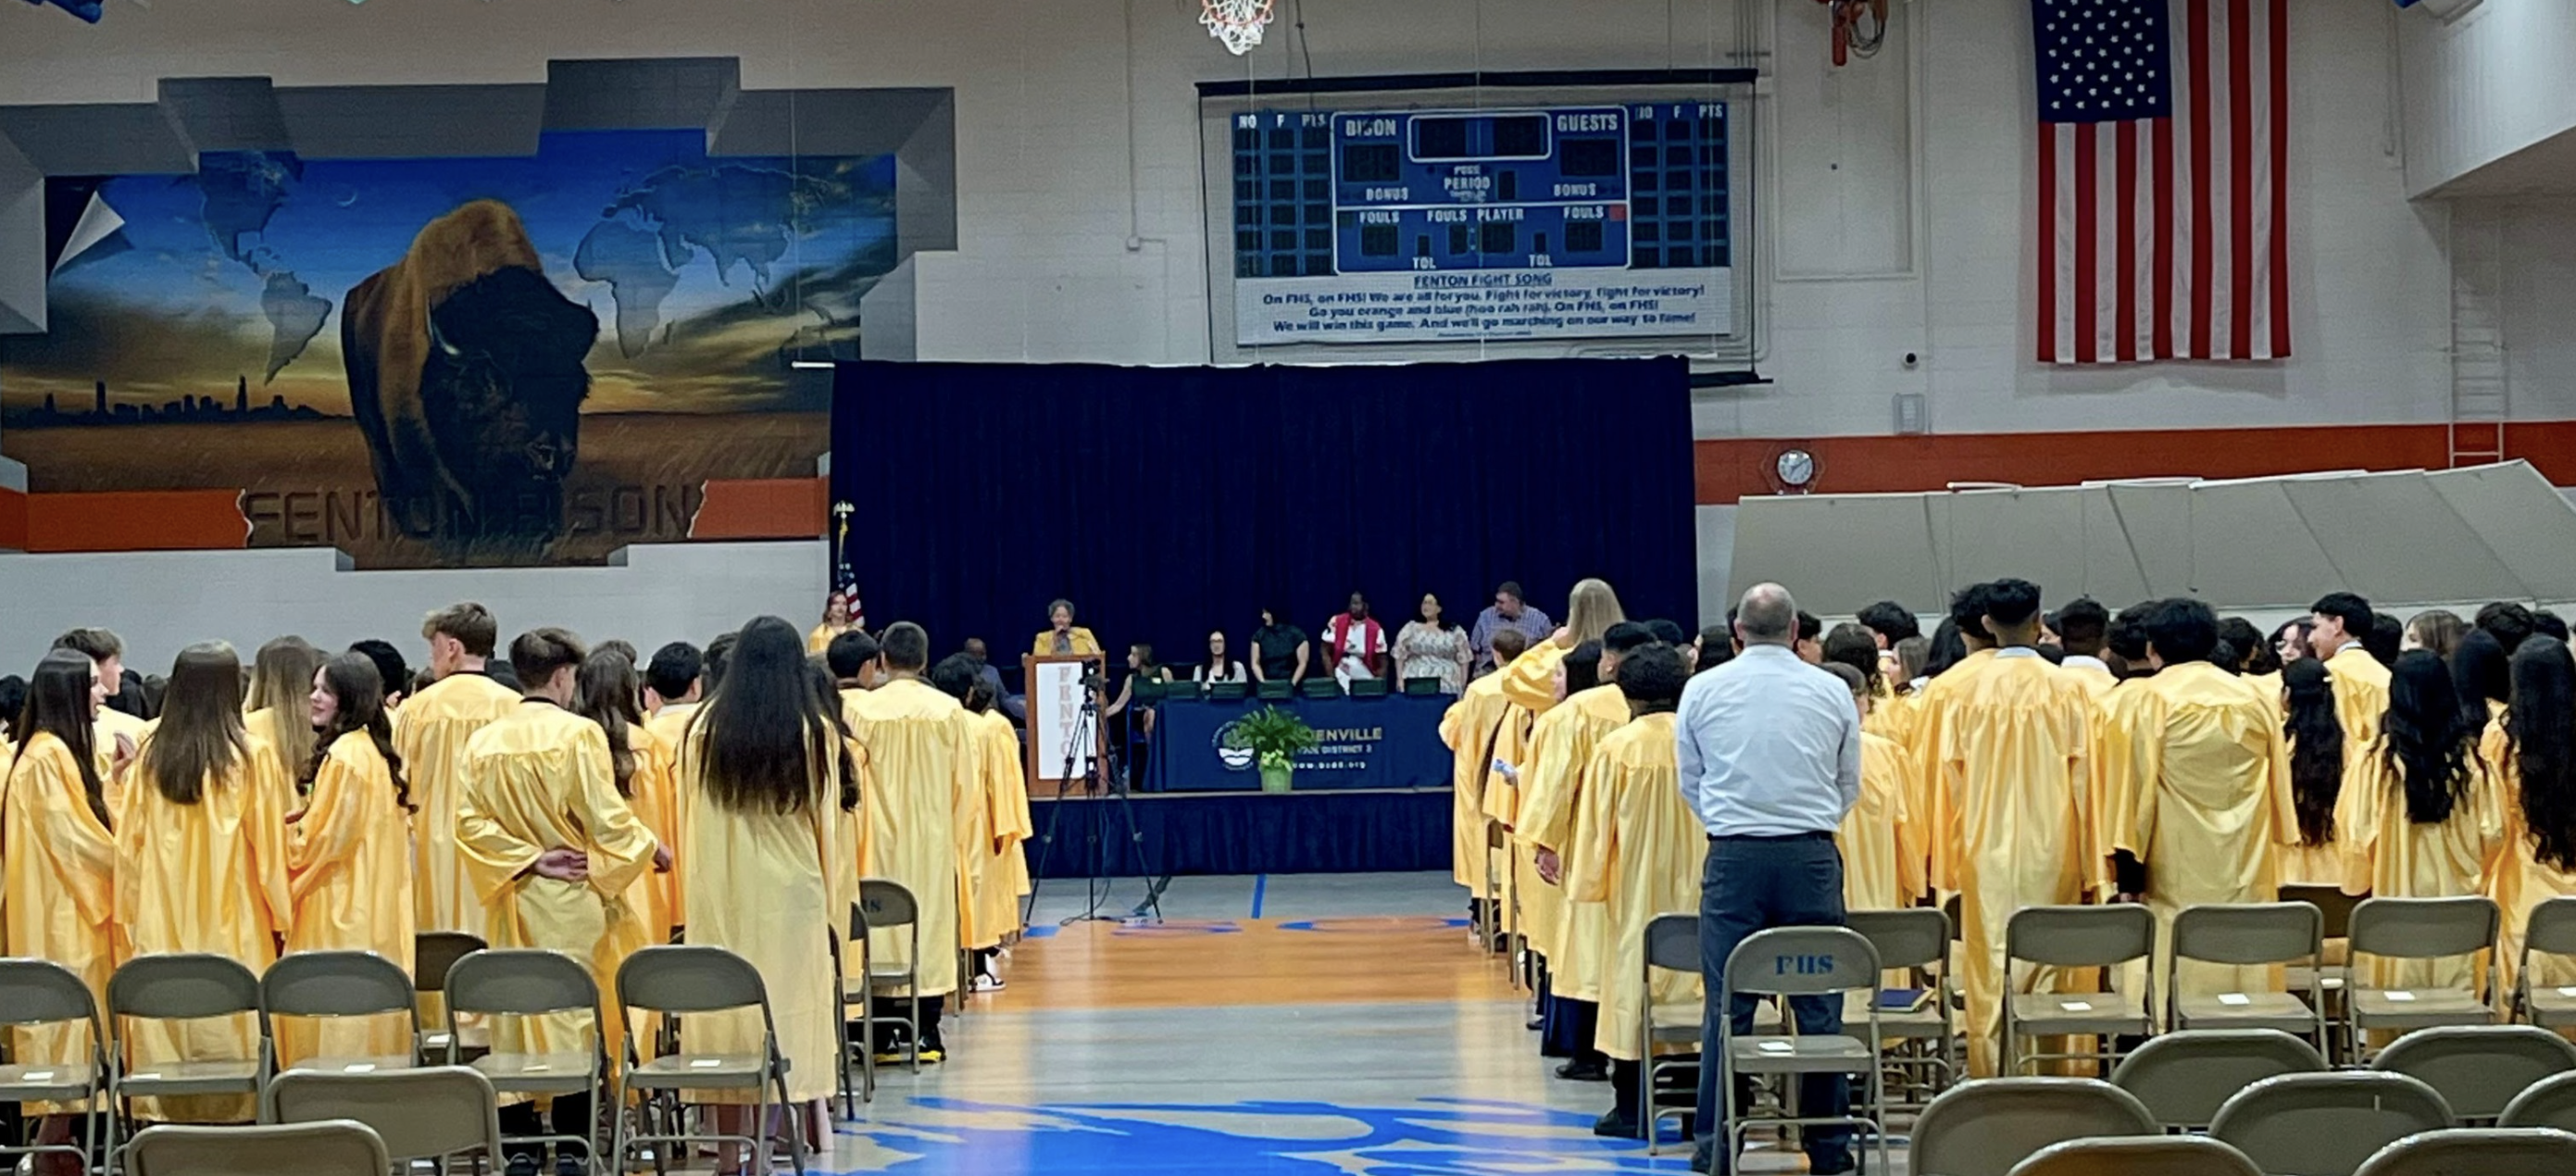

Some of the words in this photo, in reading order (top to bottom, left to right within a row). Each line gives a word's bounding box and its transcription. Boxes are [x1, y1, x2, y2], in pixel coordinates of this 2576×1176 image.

[1674, 105, 1682, 118] F
[1699, 104, 1723, 118] PTS
[1239, 114, 1257, 129] NO
[1277, 114, 1285, 128] F
[1301, 114, 1326, 128] PTS
[1345, 119, 1396, 136] BISON
[1557, 114, 1619, 131] GUESTS
[1444, 176, 1491, 191] PERIOD
[1554, 183, 1596, 196] BONUS
[1366, 187, 1409, 202] BONUS
[1359, 211, 1400, 223] FOULS
[1427, 209, 1468, 222] FOULS
[1477, 208, 1525, 222] PLAYER
[1563, 206, 1605, 219] FOULS
[1413, 256, 1436, 269] TOL
[1529, 254, 1553, 267] TOL
[1414, 275, 1469, 287] FENTON
[1471, 274, 1510, 286] FIGHT
[1515, 272, 1553, 285] SONG
[1263, 294, 1282, 305] On
[1318, 294, 1334, 304] on
[1369, 292, 1389, 303] We
[1393, 293, 1413, 302] are
[1417, 291, 1432, 301] all
[1434, 291, 1452, 301] for
[1485, 289, 1519, 302] Fight
[1523, 289, 1543, 300] for
[1596, 287, 1628, 300] fight
[1632, 286, 1651, 296] for
[1653, 284, 1705, 298] victory!
[1308, 307, 1327, 317] Go
[1330, 307, 1354, 319] you
[1357, 307, 1403, 319] orange
[1407, 306, 1432, 315] and
[1434, 305, 1463, 315] blue
[1498, 302, 1519, 313] rah
[1554, 301, 1574, 311] On
[1608, 301, 1626, 310] on
[1273, 320, 1294, 332] We
[1296, 319, 1320, 330] will
[1322, 320, 1346, 331] win
[1349, 319, 1374, 330] this
[1419, 318, 1448, 329] And
[1482, 319, 1499, 330] go
[1502, 316, 1563, 328] marching
[1567, 317, 1584, 325] on
[1587, 316, 1608, 325] our
[1611, 315, 1637, 327] way
[1643, 314, 1657, 323] to
[246, 489, 485, 544] FENTON
[515, 484, 691, 537] BISON
[1775, 955, 1834, 975] FHS
